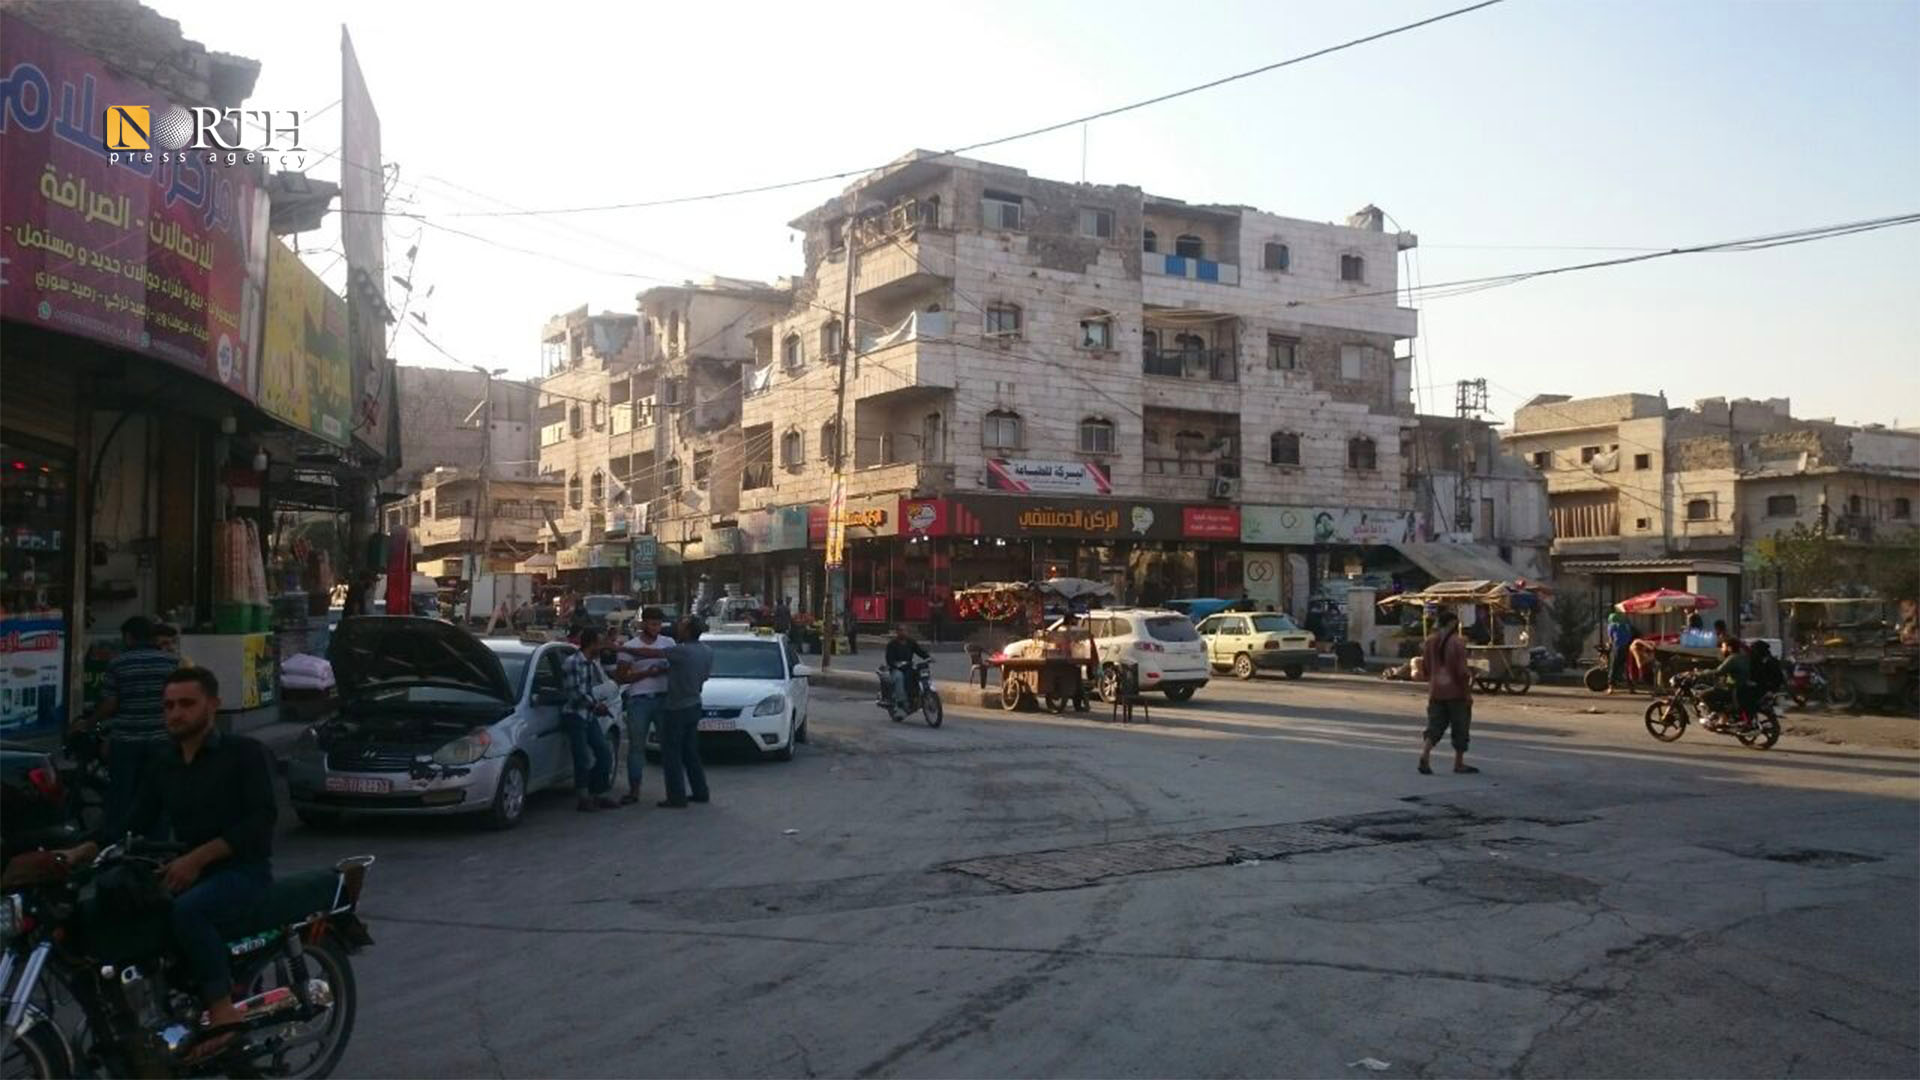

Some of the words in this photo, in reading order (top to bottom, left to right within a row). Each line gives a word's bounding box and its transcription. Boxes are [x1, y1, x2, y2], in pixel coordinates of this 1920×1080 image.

[40, 163, 130, 230] الصرافة
[1019, 507, 1083, 530] الدمشقي
[1083, 508, 1119, 532] الركن
